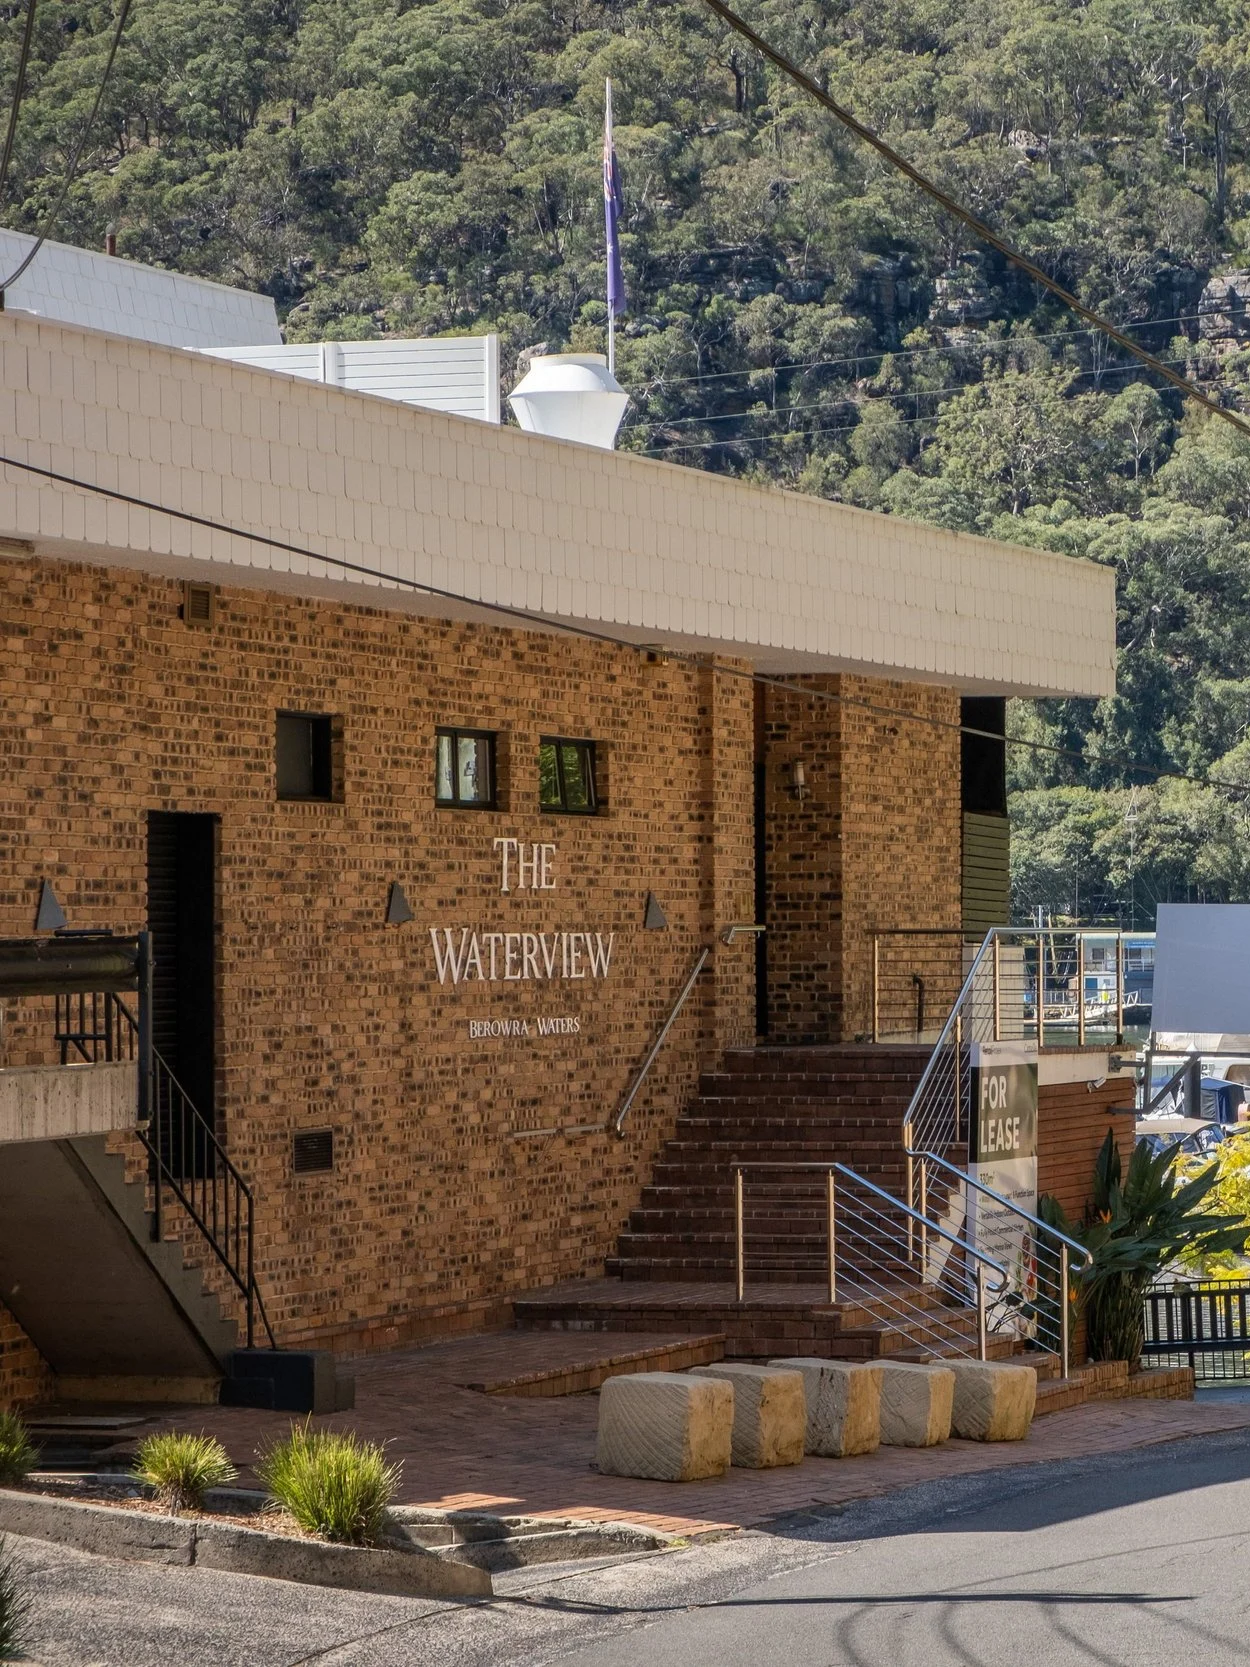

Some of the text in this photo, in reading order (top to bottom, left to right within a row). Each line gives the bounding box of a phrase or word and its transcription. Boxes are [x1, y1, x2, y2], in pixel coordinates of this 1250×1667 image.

[493, 837, 556, 892] THE
[428, 927, 615, 986] WATERVIEW
[469, 1016, 580, 1039] BEROWRA WATERS
[980, 1075, 1007, 1110] FOR
[980, 1116, 1020, 1153] LEASE
